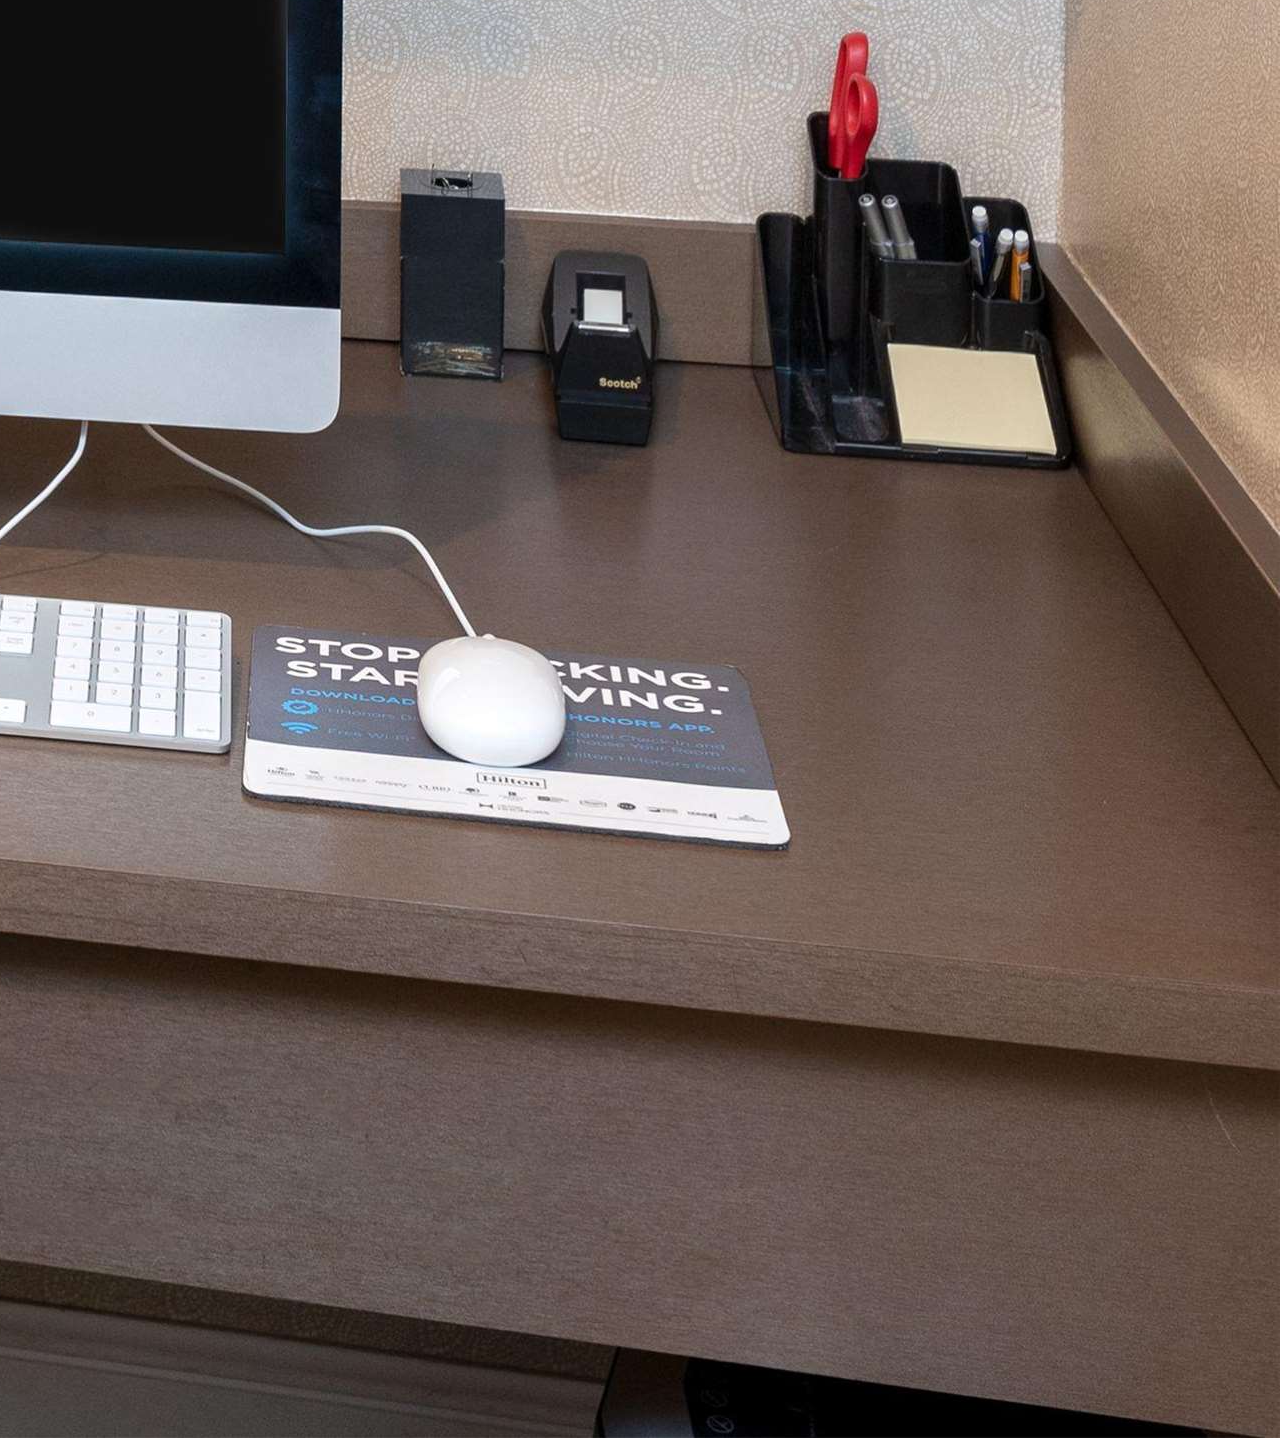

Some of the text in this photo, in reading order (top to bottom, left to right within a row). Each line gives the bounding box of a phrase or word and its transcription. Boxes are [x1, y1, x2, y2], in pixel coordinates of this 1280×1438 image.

[275, 636, 420, 662] STOP
[286, 660, 418, 687] STAR
[291, 687, 417, 706] DOWNLOAD
[669, 722, 715, 734] APP.
[482, 773, 540, 788] Hilton
